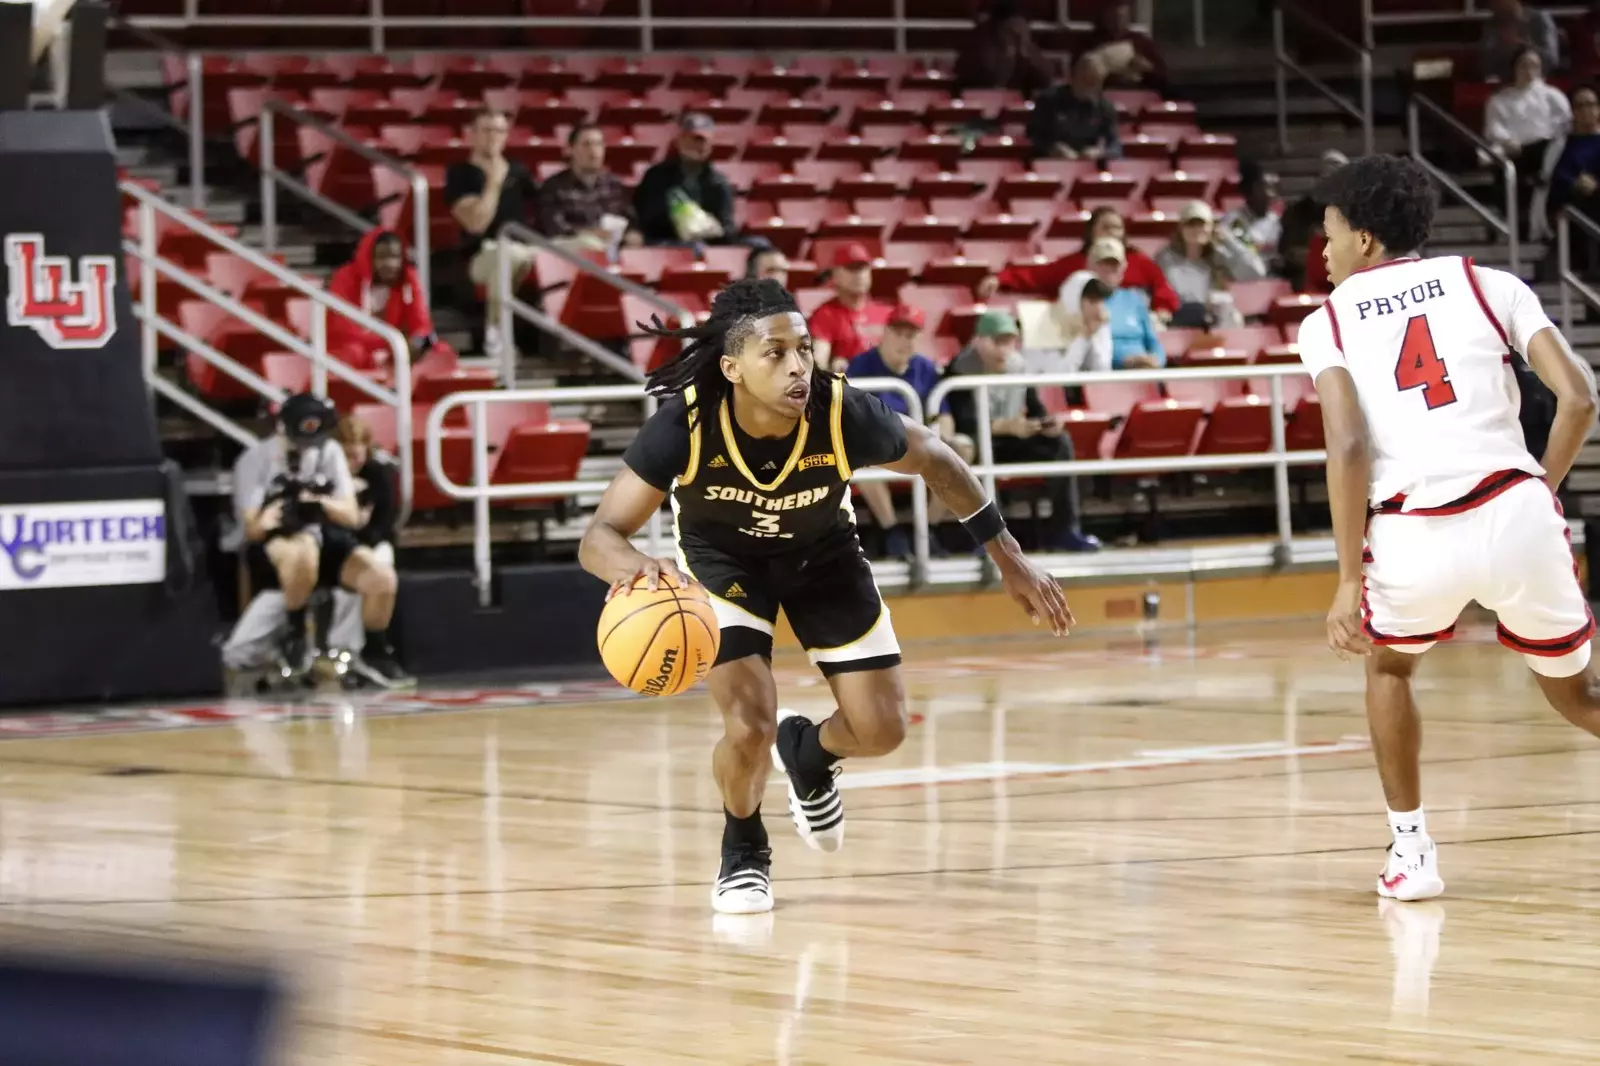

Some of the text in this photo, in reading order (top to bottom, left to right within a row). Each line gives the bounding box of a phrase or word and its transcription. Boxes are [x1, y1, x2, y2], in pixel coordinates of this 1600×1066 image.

[4, 233, 117, 349] LU
[1356, 279, 1446, 320] PRYOR
[1394, 313, 1458, 411] 4
[803, 454, 829, 468] SBC
[704, 485, 830, 511] SOUTHERN
[751, 510, 780, 533] 3
